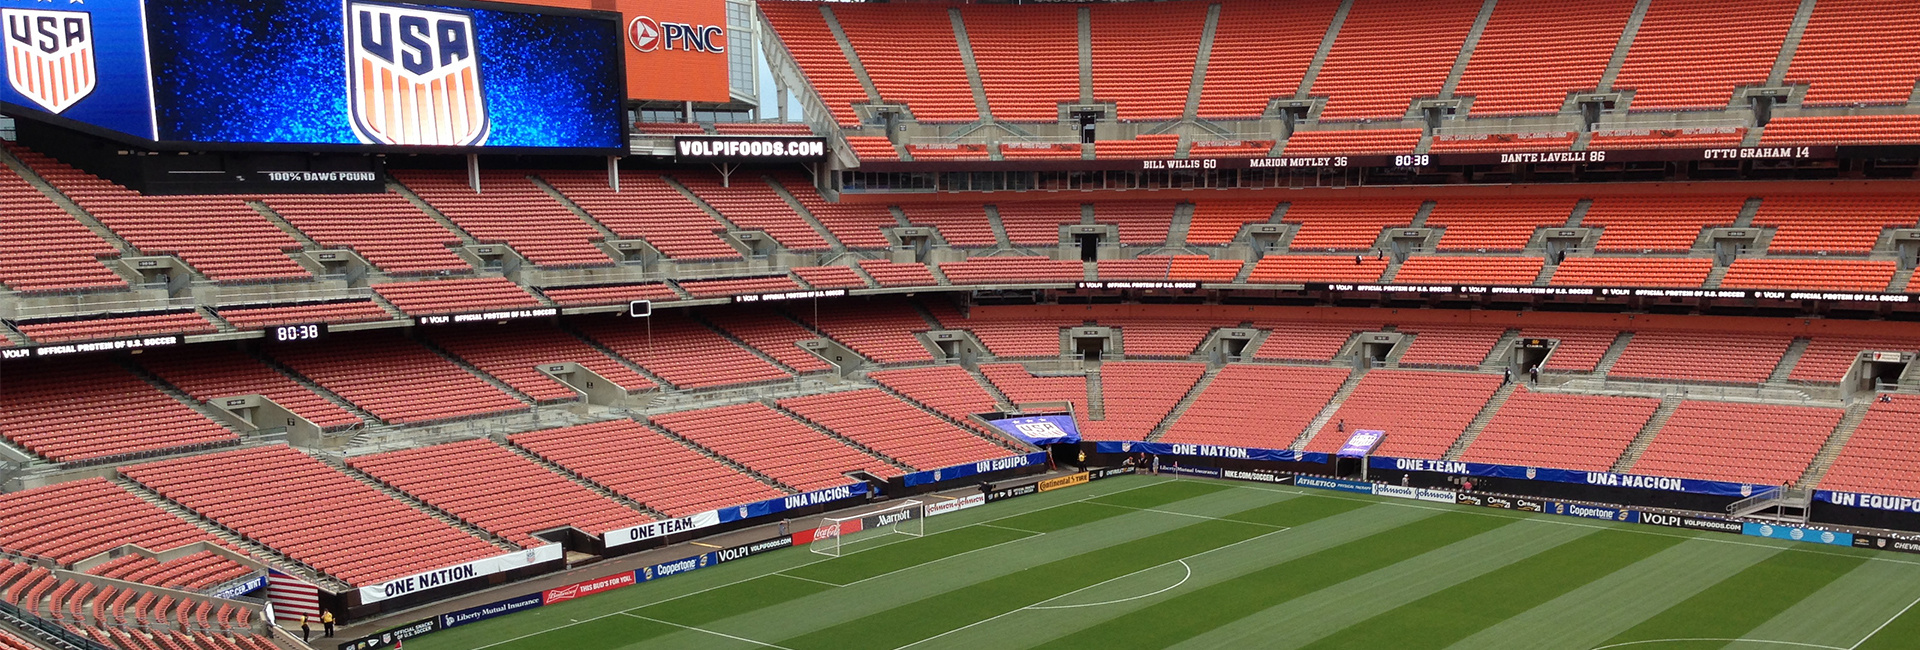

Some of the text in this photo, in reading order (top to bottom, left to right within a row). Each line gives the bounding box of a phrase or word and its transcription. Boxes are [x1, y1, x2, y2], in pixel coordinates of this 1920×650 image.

[10, 14, 85, 55] USA
[660, 22, 725, 53] PNC
[359, 10, 469, 76] USA
[679, 141, 824, 156] VOLPIFOODS.COM
[1704, 147, 1809, 158] OTTO GRAHAM 14
[1143, 159, 1216, 168] BILL WILLIS 60
[1250, 156, 1348, 167] MARION MOTLEY 36
[1395, 155, 1429, 166] 80:38
[1501, 151, 1605, 162] DANTE LAVELLI 86
[269, 172, 376, 181] 100% DAWG POUND
[278, 325, 318, 340] 80:38
[2, 349, 30, 358] VOLPI
[37, 346, 76, 355] OFFICIAL
[114, 341, 126, 349] OF
[127, 339, 143, 347] U.S.
[144, 336, 176, 346] SOCCER
[1172, 444, 1250, 459] ONE NATION.
[976, 454, 1030, 473] UN EQUIPO.
[1396, 458, 1470, 474] ONE TEAM.
[1040, 477, 1071, 492] Continental
[1076, 474, 1087, 482] TIRE
[1224, 470, 1274, 482] NIKE.COM/SOCCER
[1297, 477, 1336, 488] ATHLETICO
[1587, 472, 1618, 486] UNA
[1374, 482, 1454, 500] Johnson's Johnson's
[785, 494, 808, 509] UNA
[1831, 492, 1855, 506] UN
[876, 510, 911, 527] Marriott
[1570, 504, 1614, 518] Coppertone
[630, 517, 696, 541] ONE TEAM.
[1642, 512, 1741, 531] VOLPI VOLPIFOODS.COM
[718, 537, 792, 562] VOLPI VOLPIFOODS.COM
[657, 559, 696, 576] Coppertone
[384, 564, 477, 597] ONE NATION.
[609, 578, 620, 586] FOR
[456, 598, 540, 622] Liberty Mutual Insurance
[394, 627, 414, 637] OFFICIAL
[414, 626, 432, 635] SOCCER
